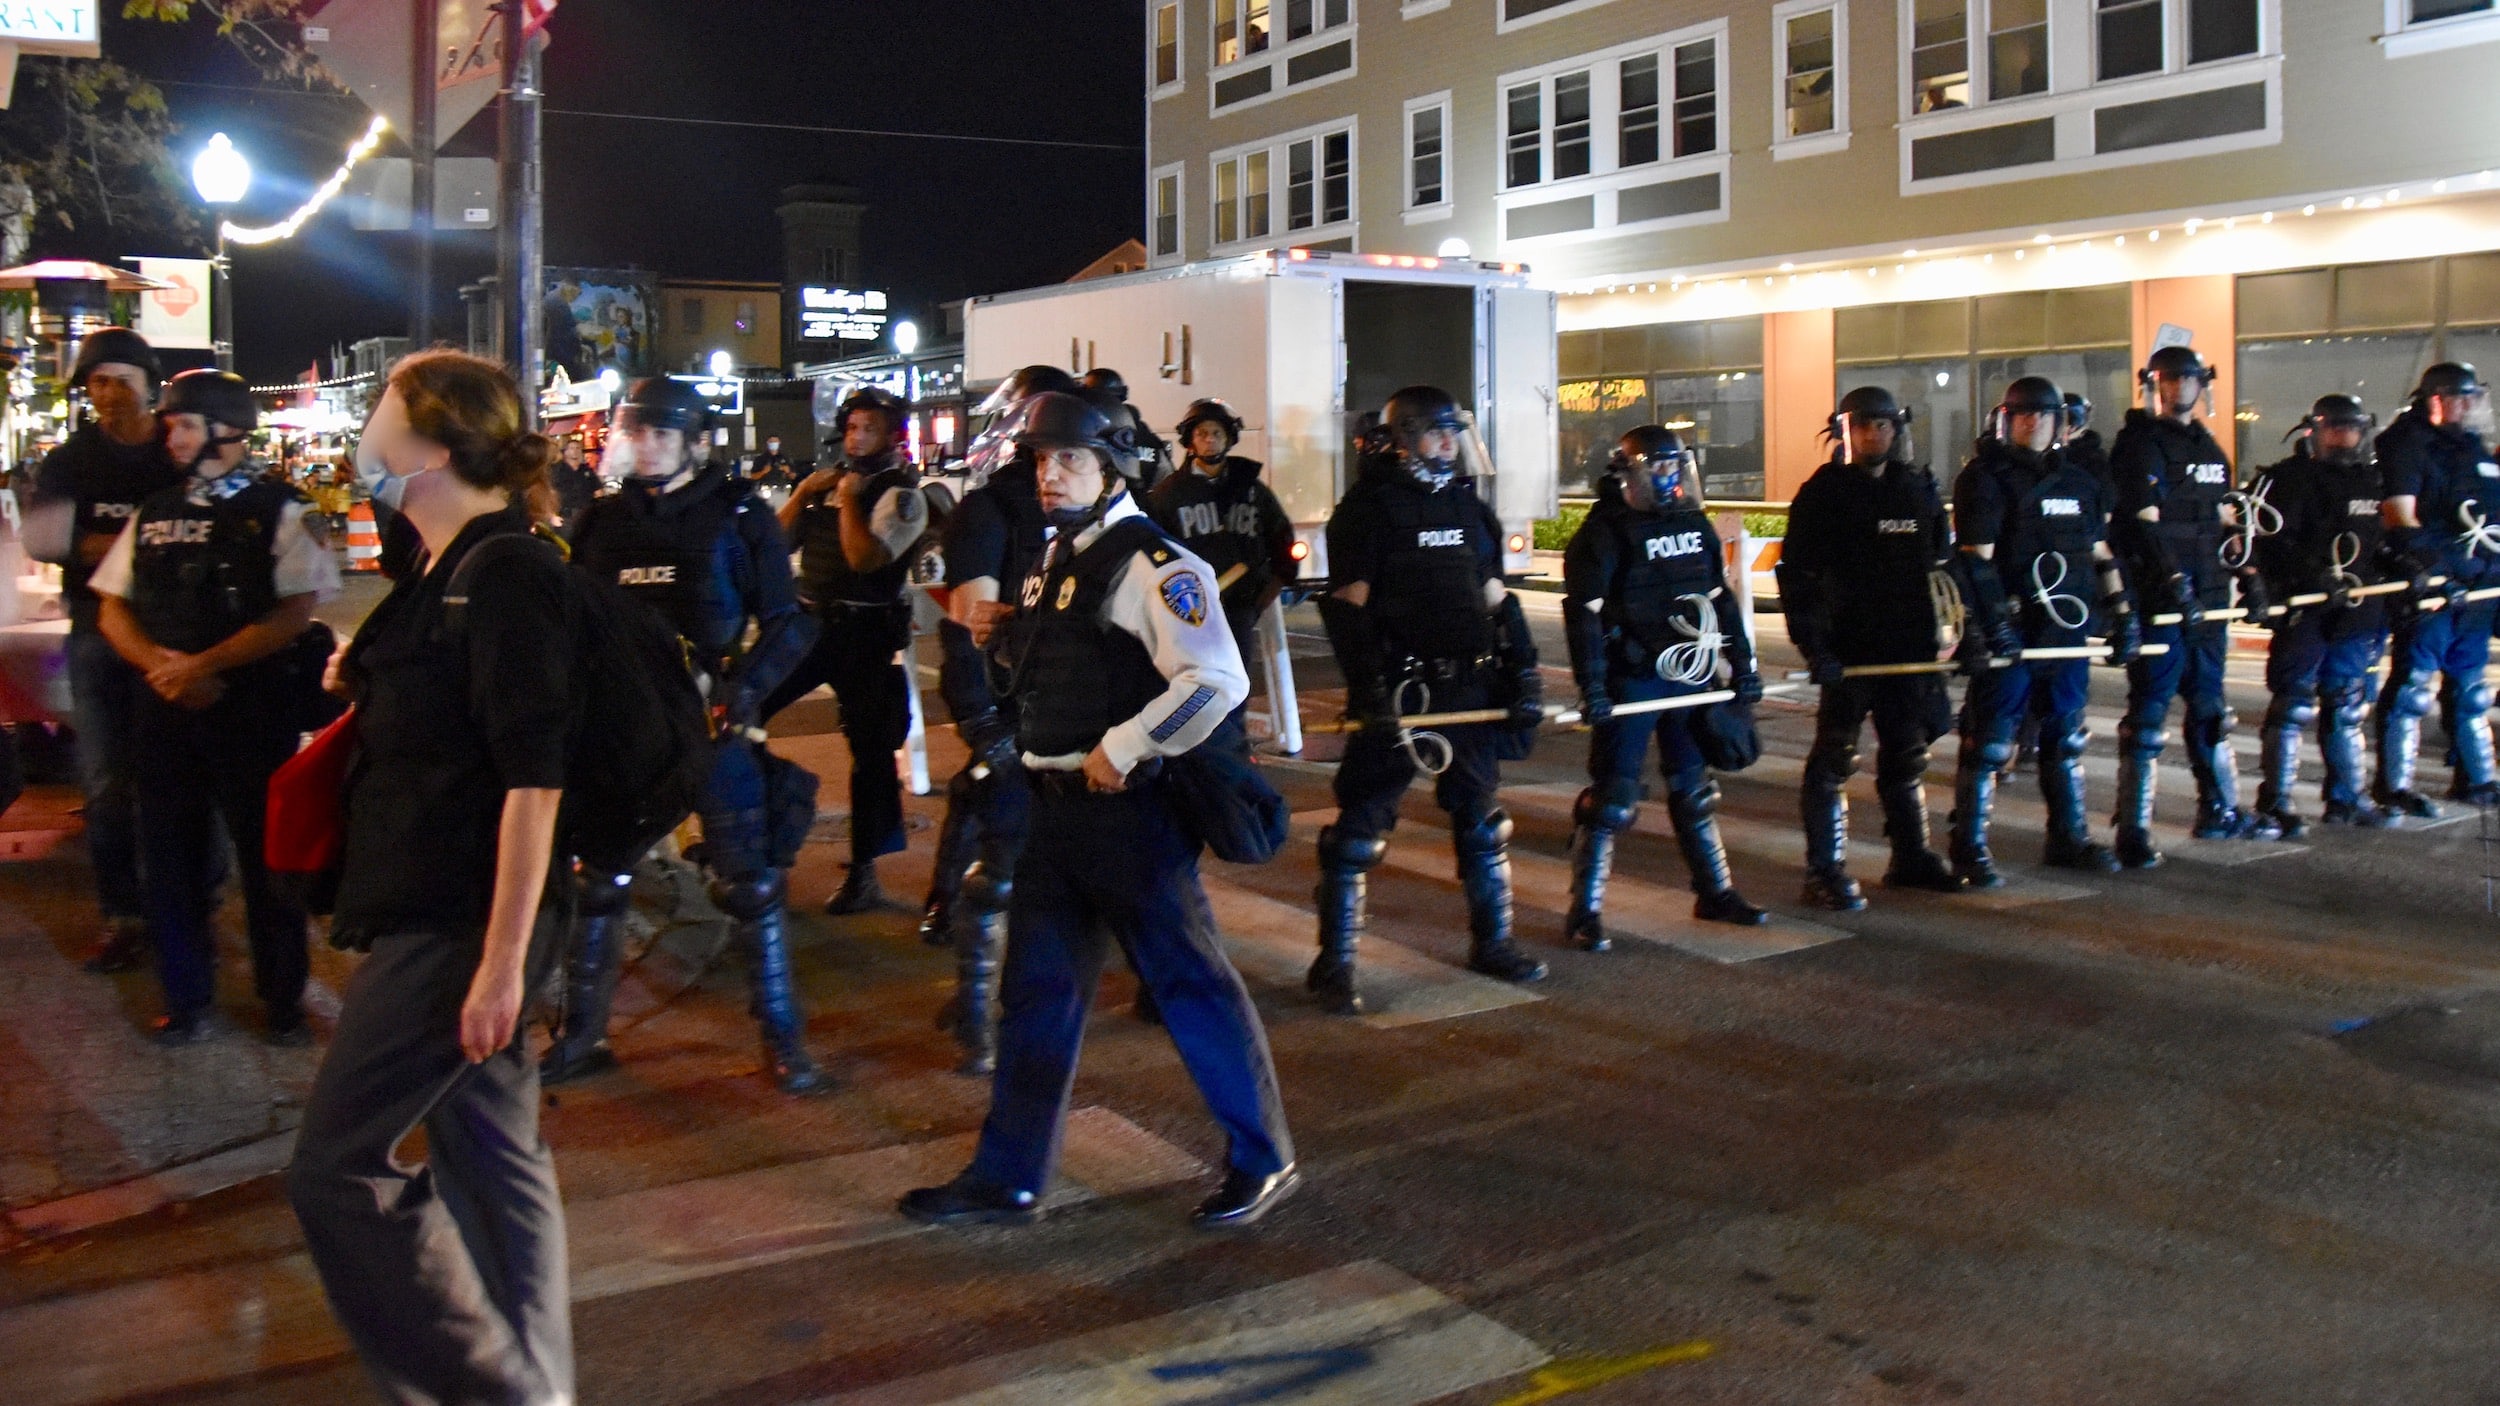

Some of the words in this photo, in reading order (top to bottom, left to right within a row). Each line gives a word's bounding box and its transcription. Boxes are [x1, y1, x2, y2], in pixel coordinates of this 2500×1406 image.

[1879, 519, 1919, 534] POLICE
[1418, 529, 1464, 547] POLICE
[1646, 531, 1703, 560] POLICE
[619, 565, 676, 584] POLICE
